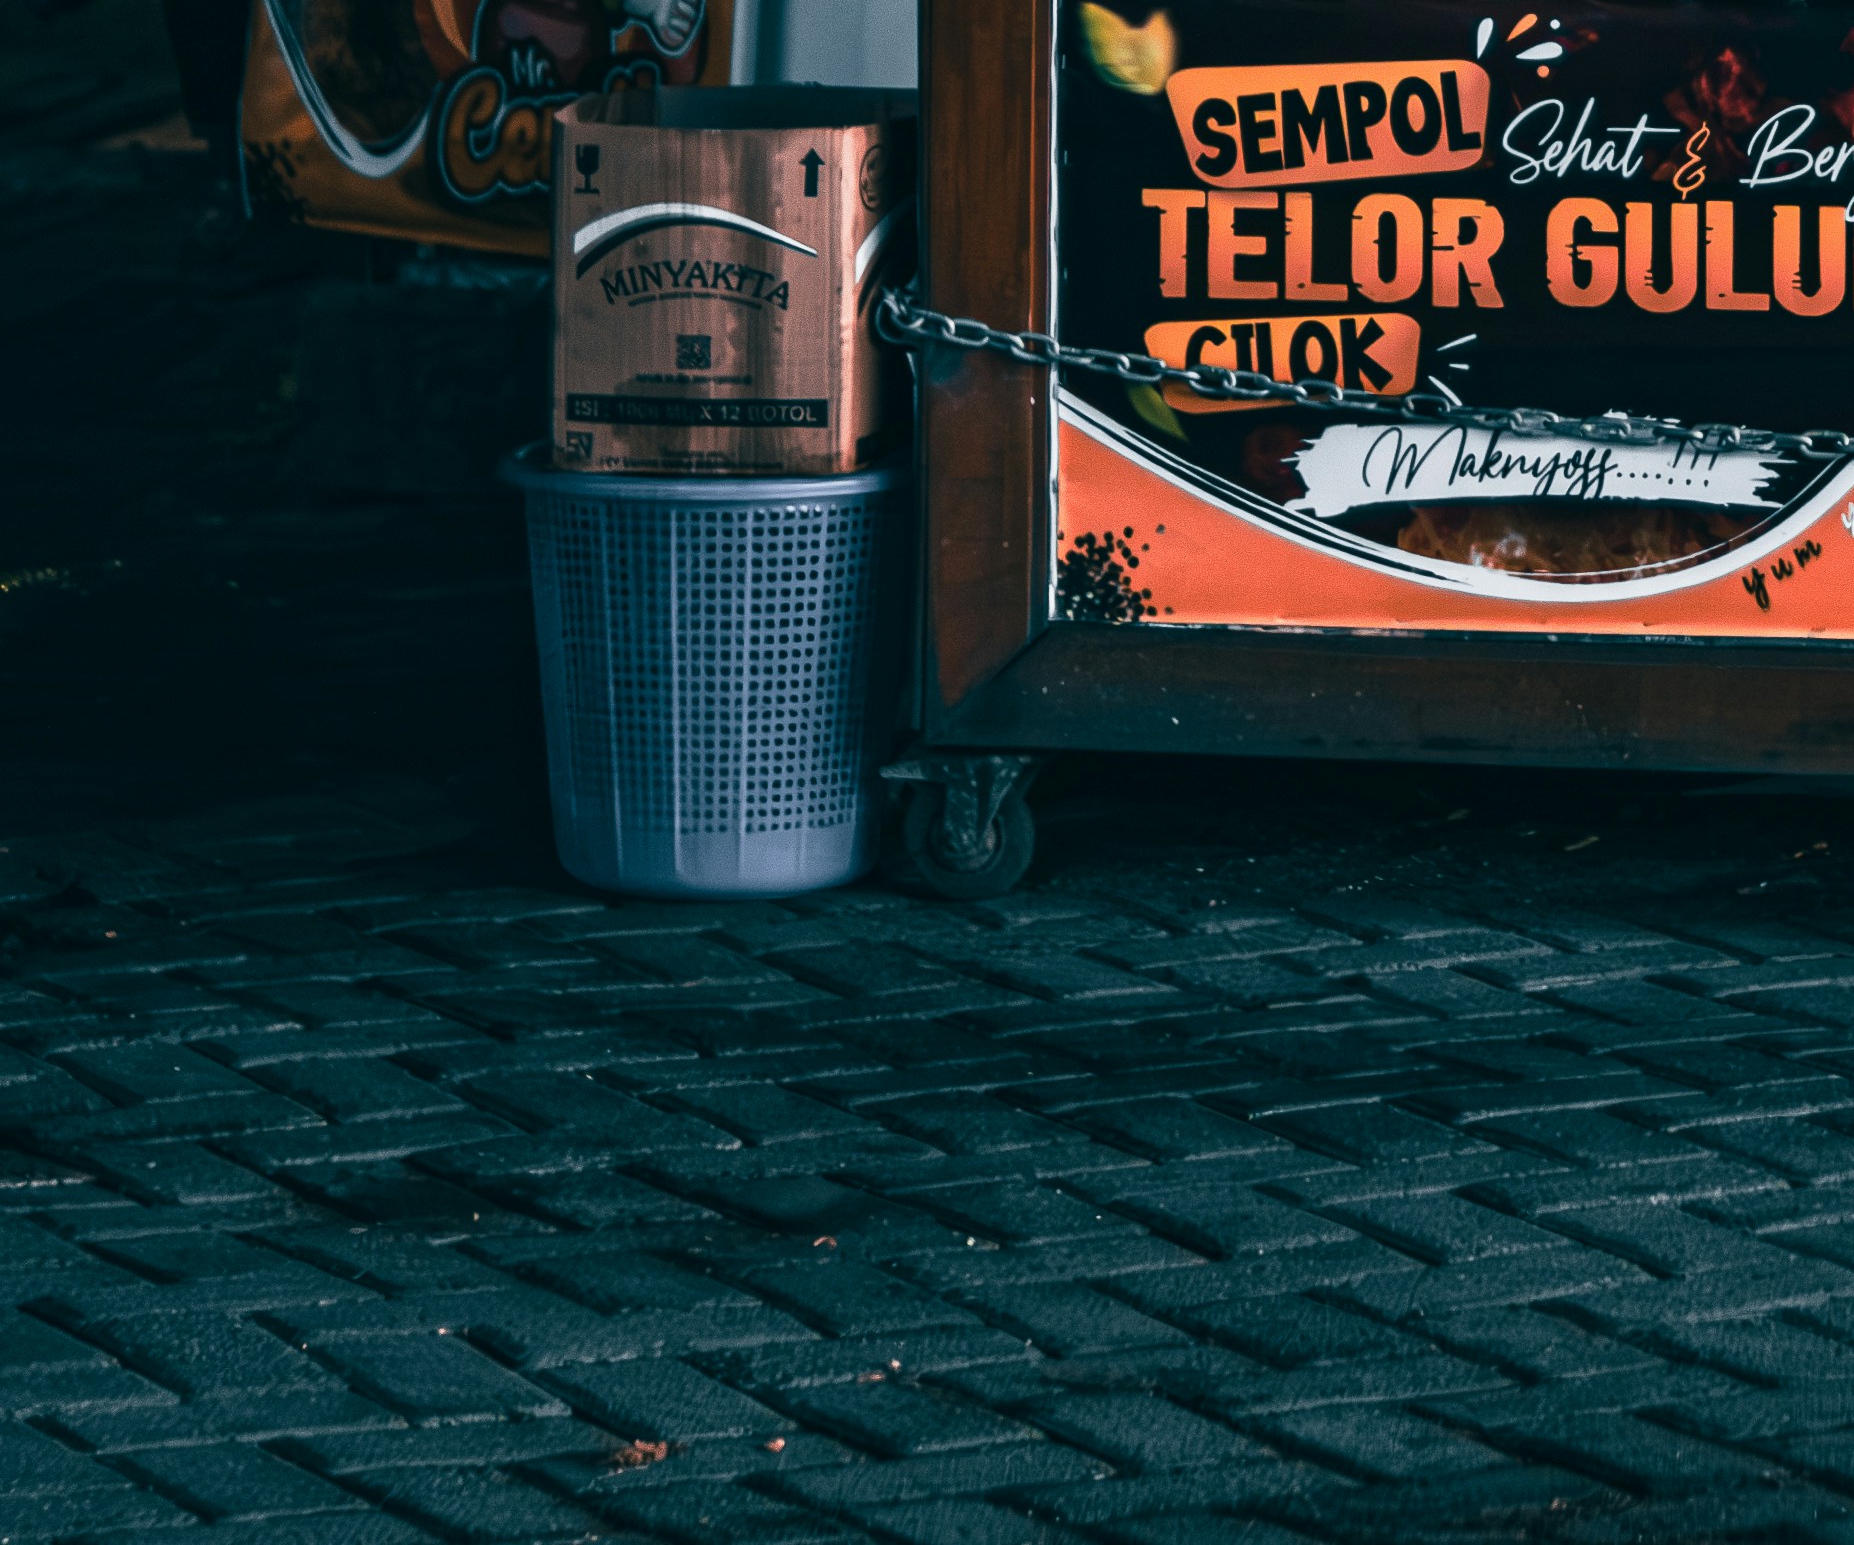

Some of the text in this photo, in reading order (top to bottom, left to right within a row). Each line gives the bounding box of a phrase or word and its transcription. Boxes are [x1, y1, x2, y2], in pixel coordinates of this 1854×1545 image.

[1192, 69, 1482, 178] SEMPOL
[1501, 96, 1681, 185] Sehat
[1672, 120, 1710, 200] &
[600, 259, 790, 310] MINYAKITA
[1141, 188, 1505, 309] TELOR
[1184, 316, 1395, 393] CILOK
[700, 405, 713, 421] X
[721, 405, 741, 421] 12
[748, 405, 818, 423] BOTOL
[1741, 538, 1823, 611] yum
